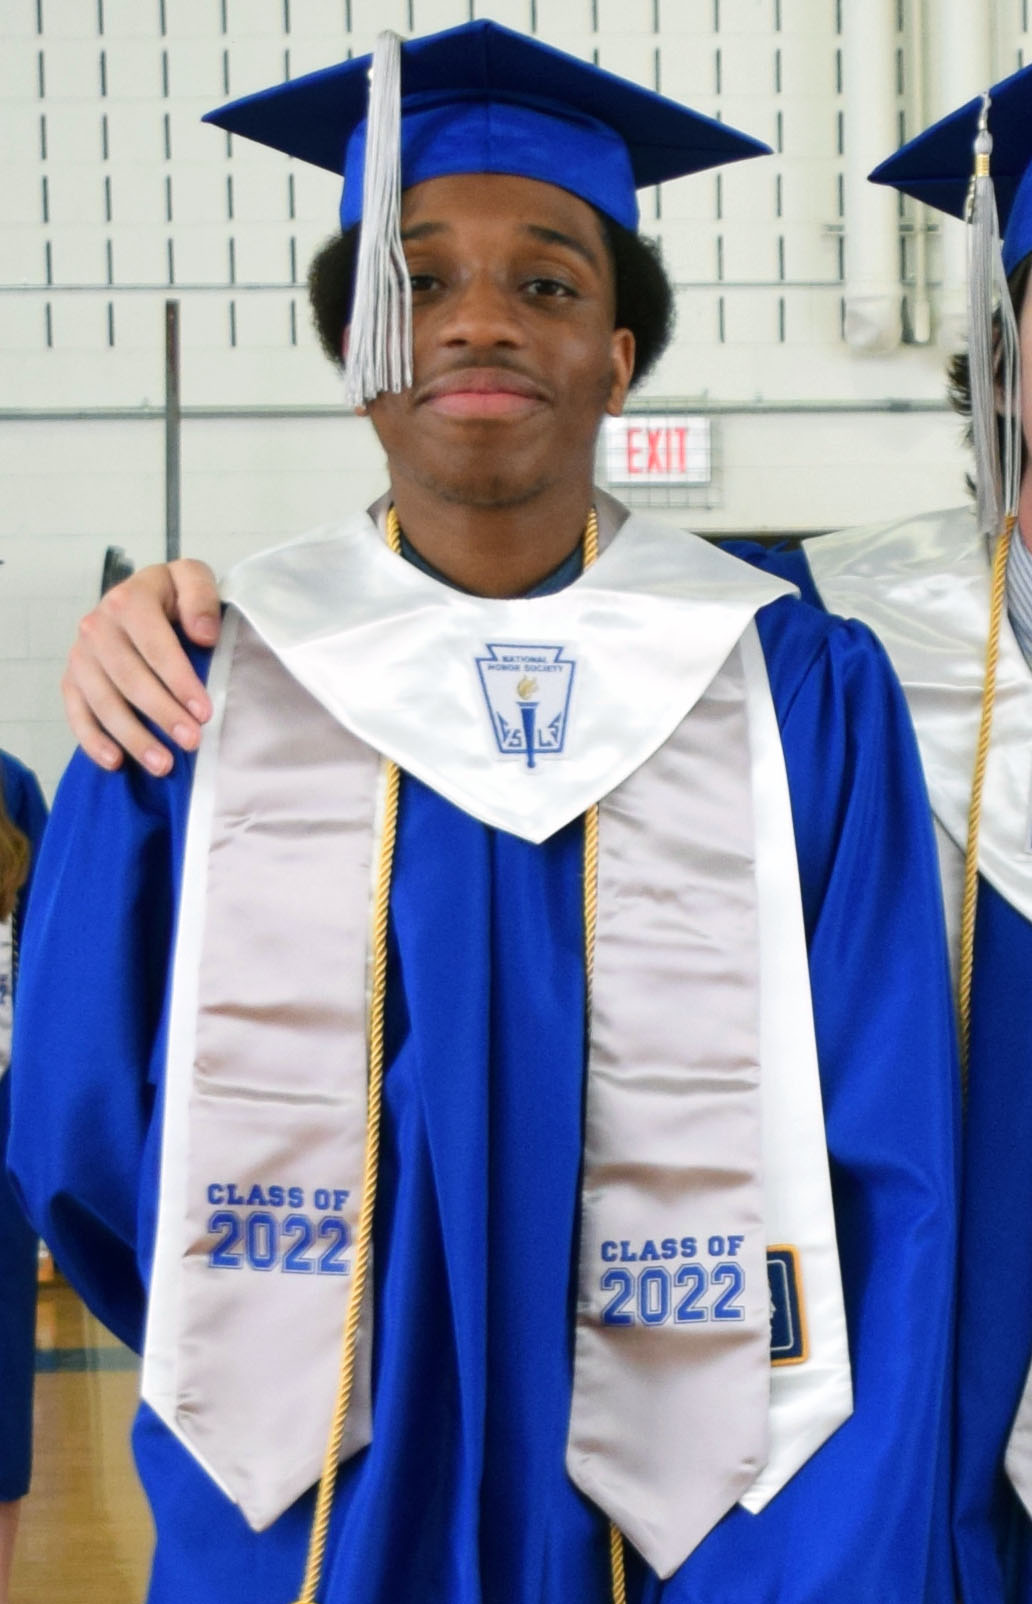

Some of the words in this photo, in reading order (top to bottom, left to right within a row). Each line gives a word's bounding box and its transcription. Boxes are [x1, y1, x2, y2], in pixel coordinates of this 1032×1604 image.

[626, 427, 687, 474] EXIT
[488, 664, 520, 672] HONOR
[524, 664, 563, 672] SOCIETY
[502, 655, 547, 663] NATIONAL
[207, 1183, 304, 1208] CLASS
[313, 1188, 350, 1211] OF
[207, 1210, 351, 1276] 2022
[601, 1237, 697, 1262] CLASS
[707, 1235, 744, 1256] OF
[600, 1261, 745, 1327] 2022
